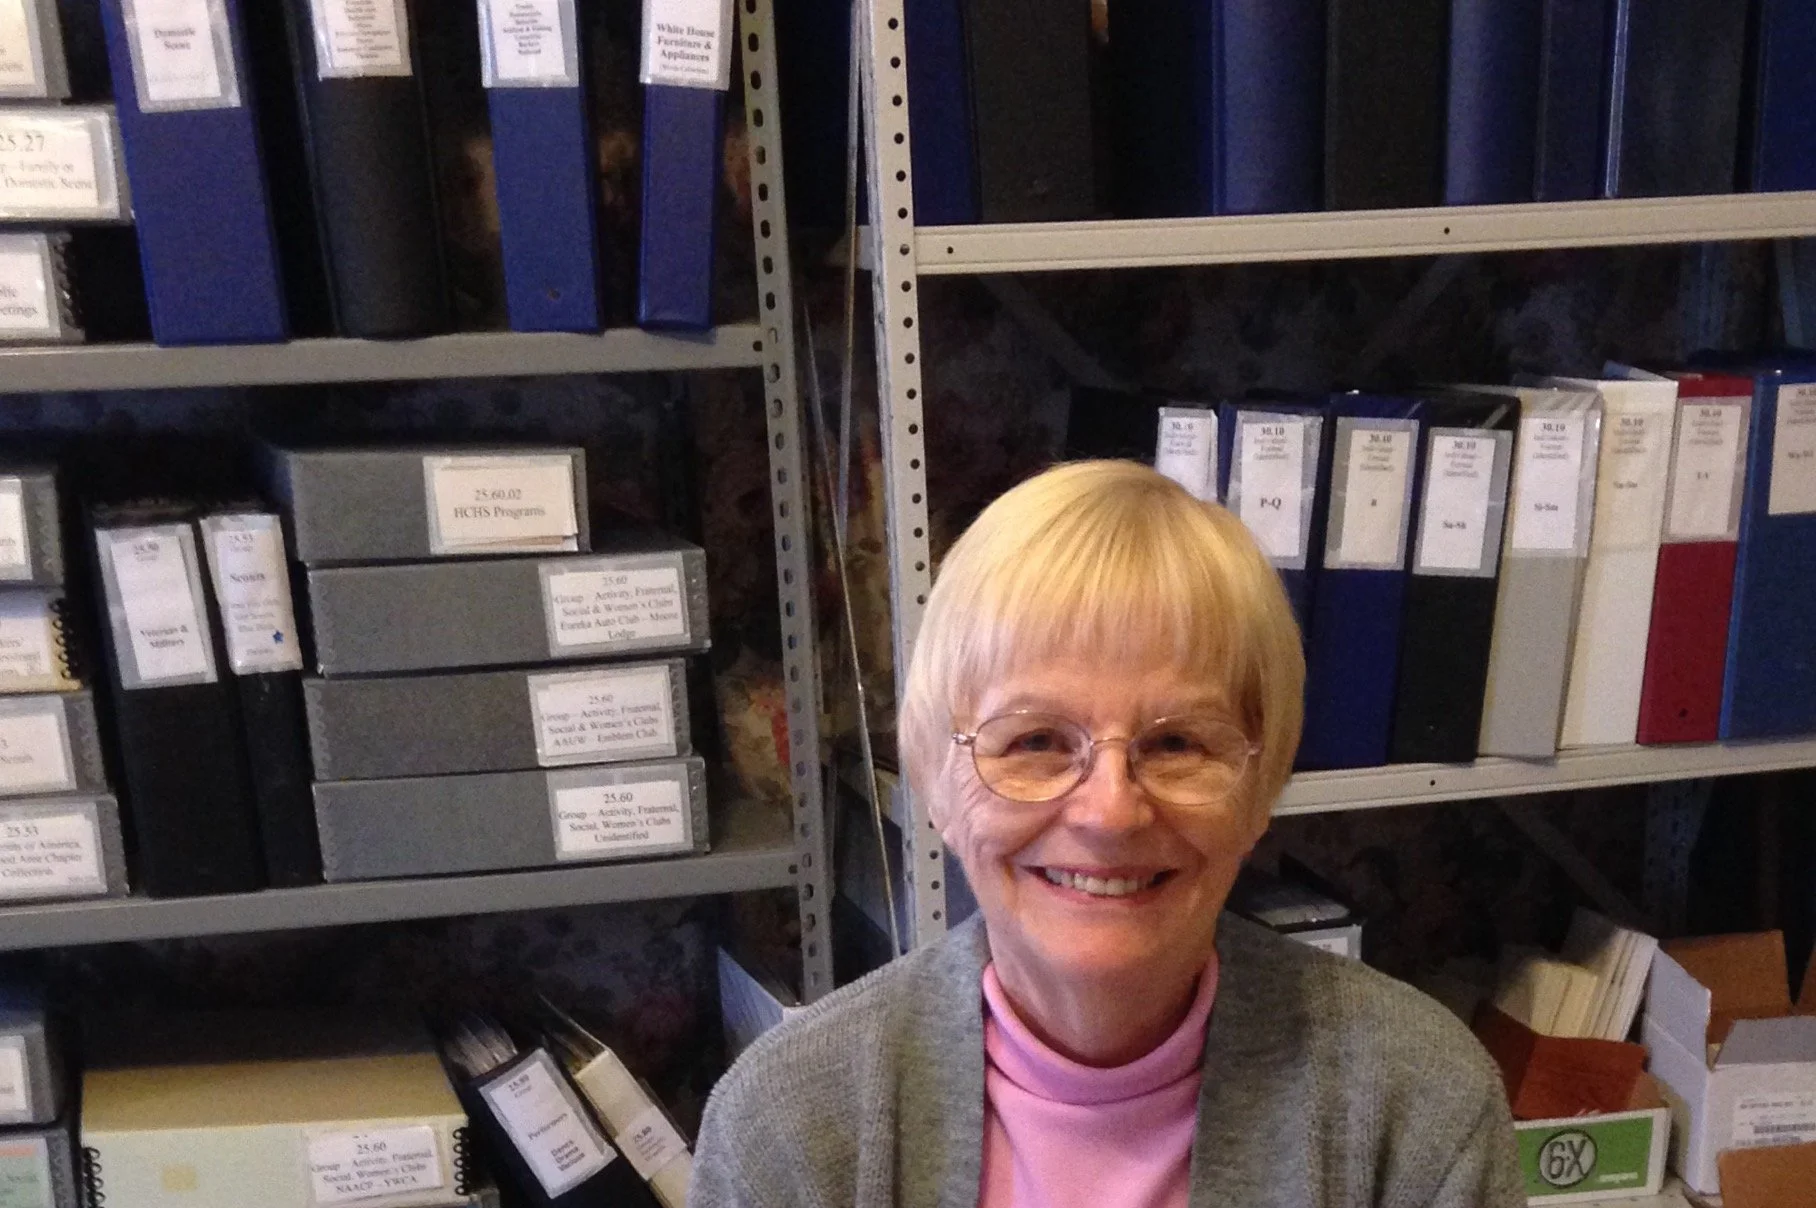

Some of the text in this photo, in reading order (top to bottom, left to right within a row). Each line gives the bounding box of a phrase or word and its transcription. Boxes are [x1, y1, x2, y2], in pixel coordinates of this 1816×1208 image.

[657, 23, 715, 38] White House
[657, 36, 712, 50] Furniture &
[662, 49, 710, 62] Appliances
[475, 487, 522, 501] 25.60.02
[1260, 497, 1282, 511] P-Q
[454, 506, 546, 520] HCHS Programs
[562, 605, 590, 617] Social
[595, 617, 617, 627] Auto
[618, 615, 640, 625] Club
[607, 628, 637, 640] Lodge
[548, 724, 576, 735] Social
[603, 792, 634, 804] 25.60
[558, 810, 588, 821] Group
[646, 817, 672, 827] Clubs
[594, 831, 650, 843] Unidentified
[356, 1142, 387, 1155] 25.60
